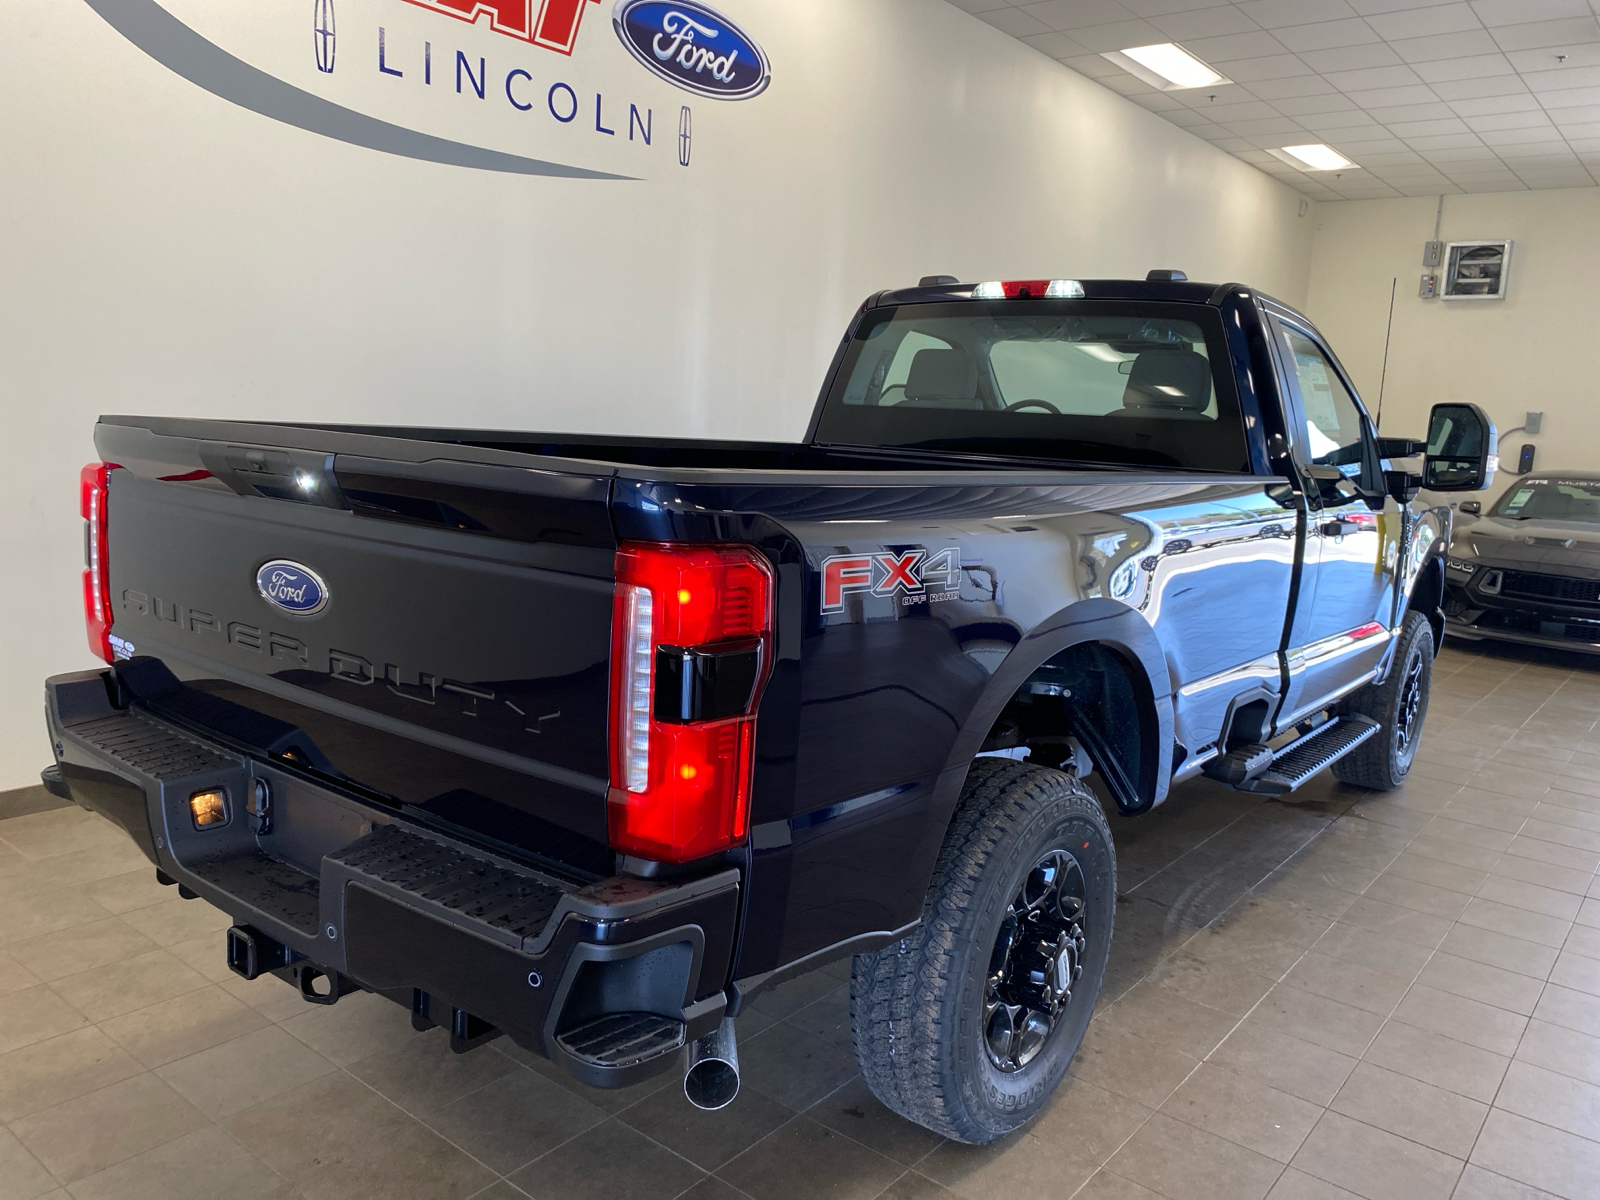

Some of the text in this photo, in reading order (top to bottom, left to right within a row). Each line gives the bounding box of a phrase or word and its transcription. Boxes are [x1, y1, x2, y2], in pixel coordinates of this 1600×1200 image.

[652, 11, 739, 84] Ford
[378, 26, 653, 146] LINCOLN
[268, 570, 308, 604] Ford
[820, 547, 962, 615] FX4
[902, 591, 960, 605] OFF ROAD
[122, 588, 561, 734] SUPER DUTY
